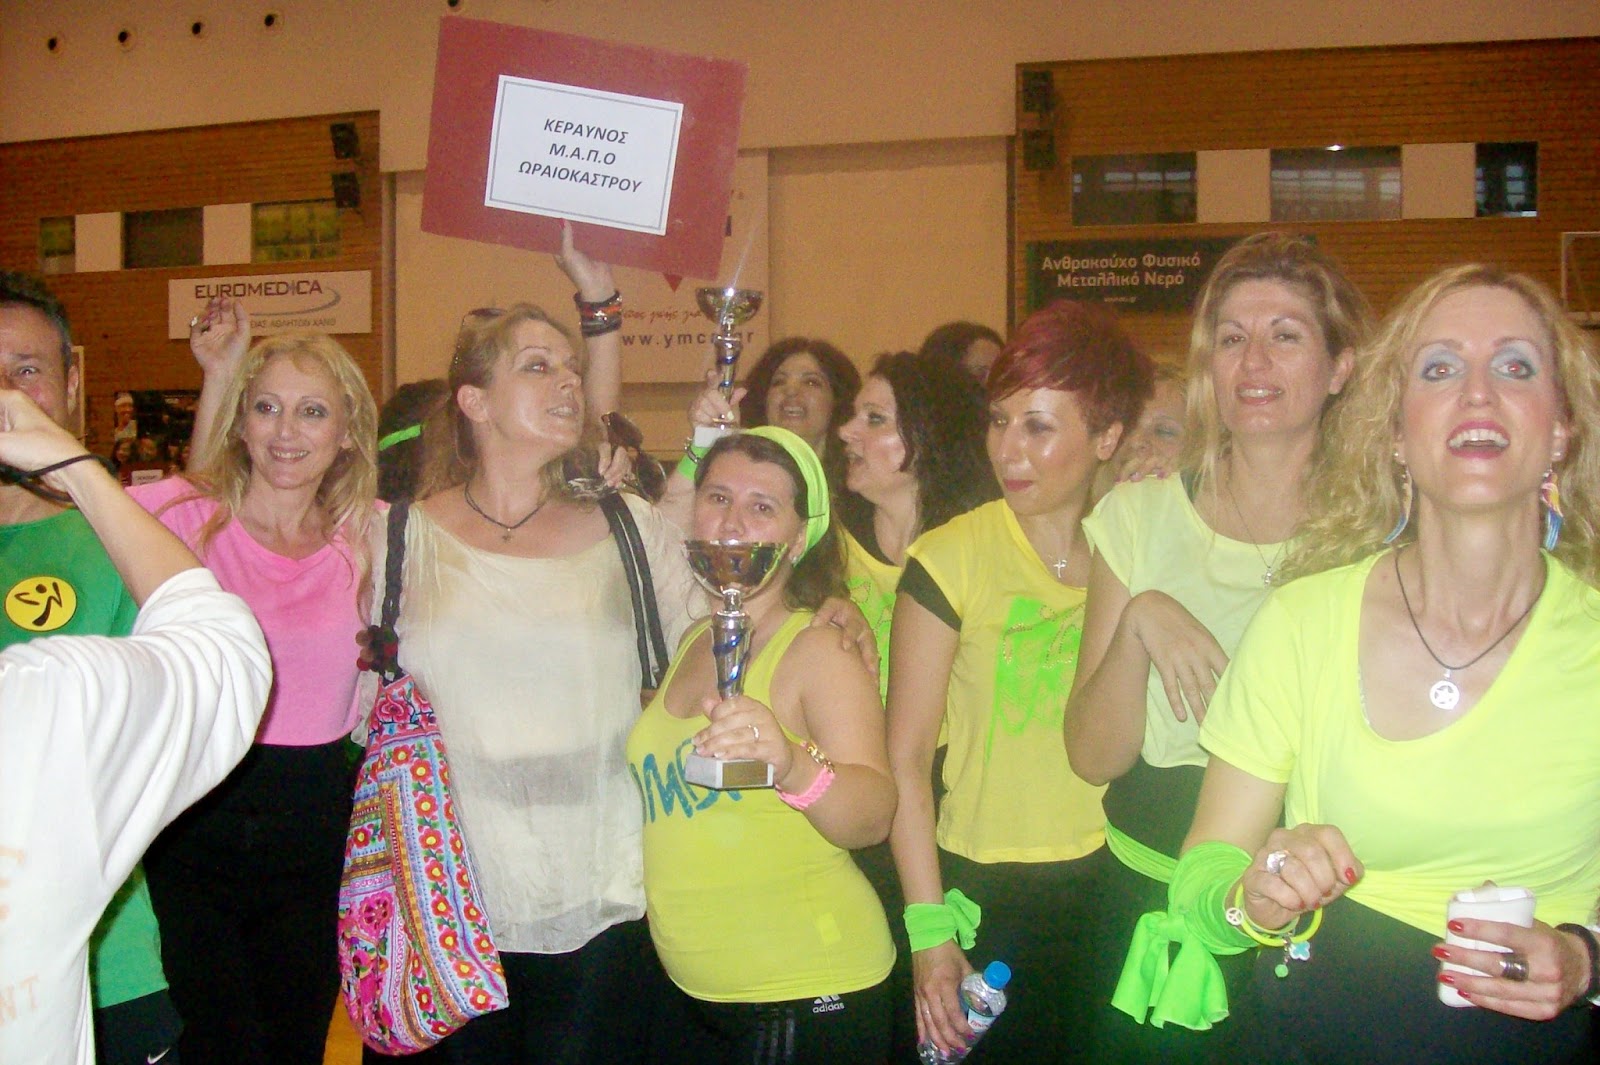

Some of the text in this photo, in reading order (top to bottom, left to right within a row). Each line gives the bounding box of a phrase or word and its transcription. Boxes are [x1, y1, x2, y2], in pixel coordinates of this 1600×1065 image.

[544, 118, 629, 144] ΚΕΡΑΥΝΟΣ
[549, 143, 616, 165] Μ.Α.Π.Ο
[518, 161, 642, 193] ΩΡΑΙΟΚΑΣΤΡΟΥ
[1042, 251, 1200, 272] Ανθρακούχο Φυσικό
[195, 279, 323, 299] EUROMEDICA
[1057, 270, 1185, 288] Μεταλλικό Νερό
[812, 1002, 845, 1013] adidas
